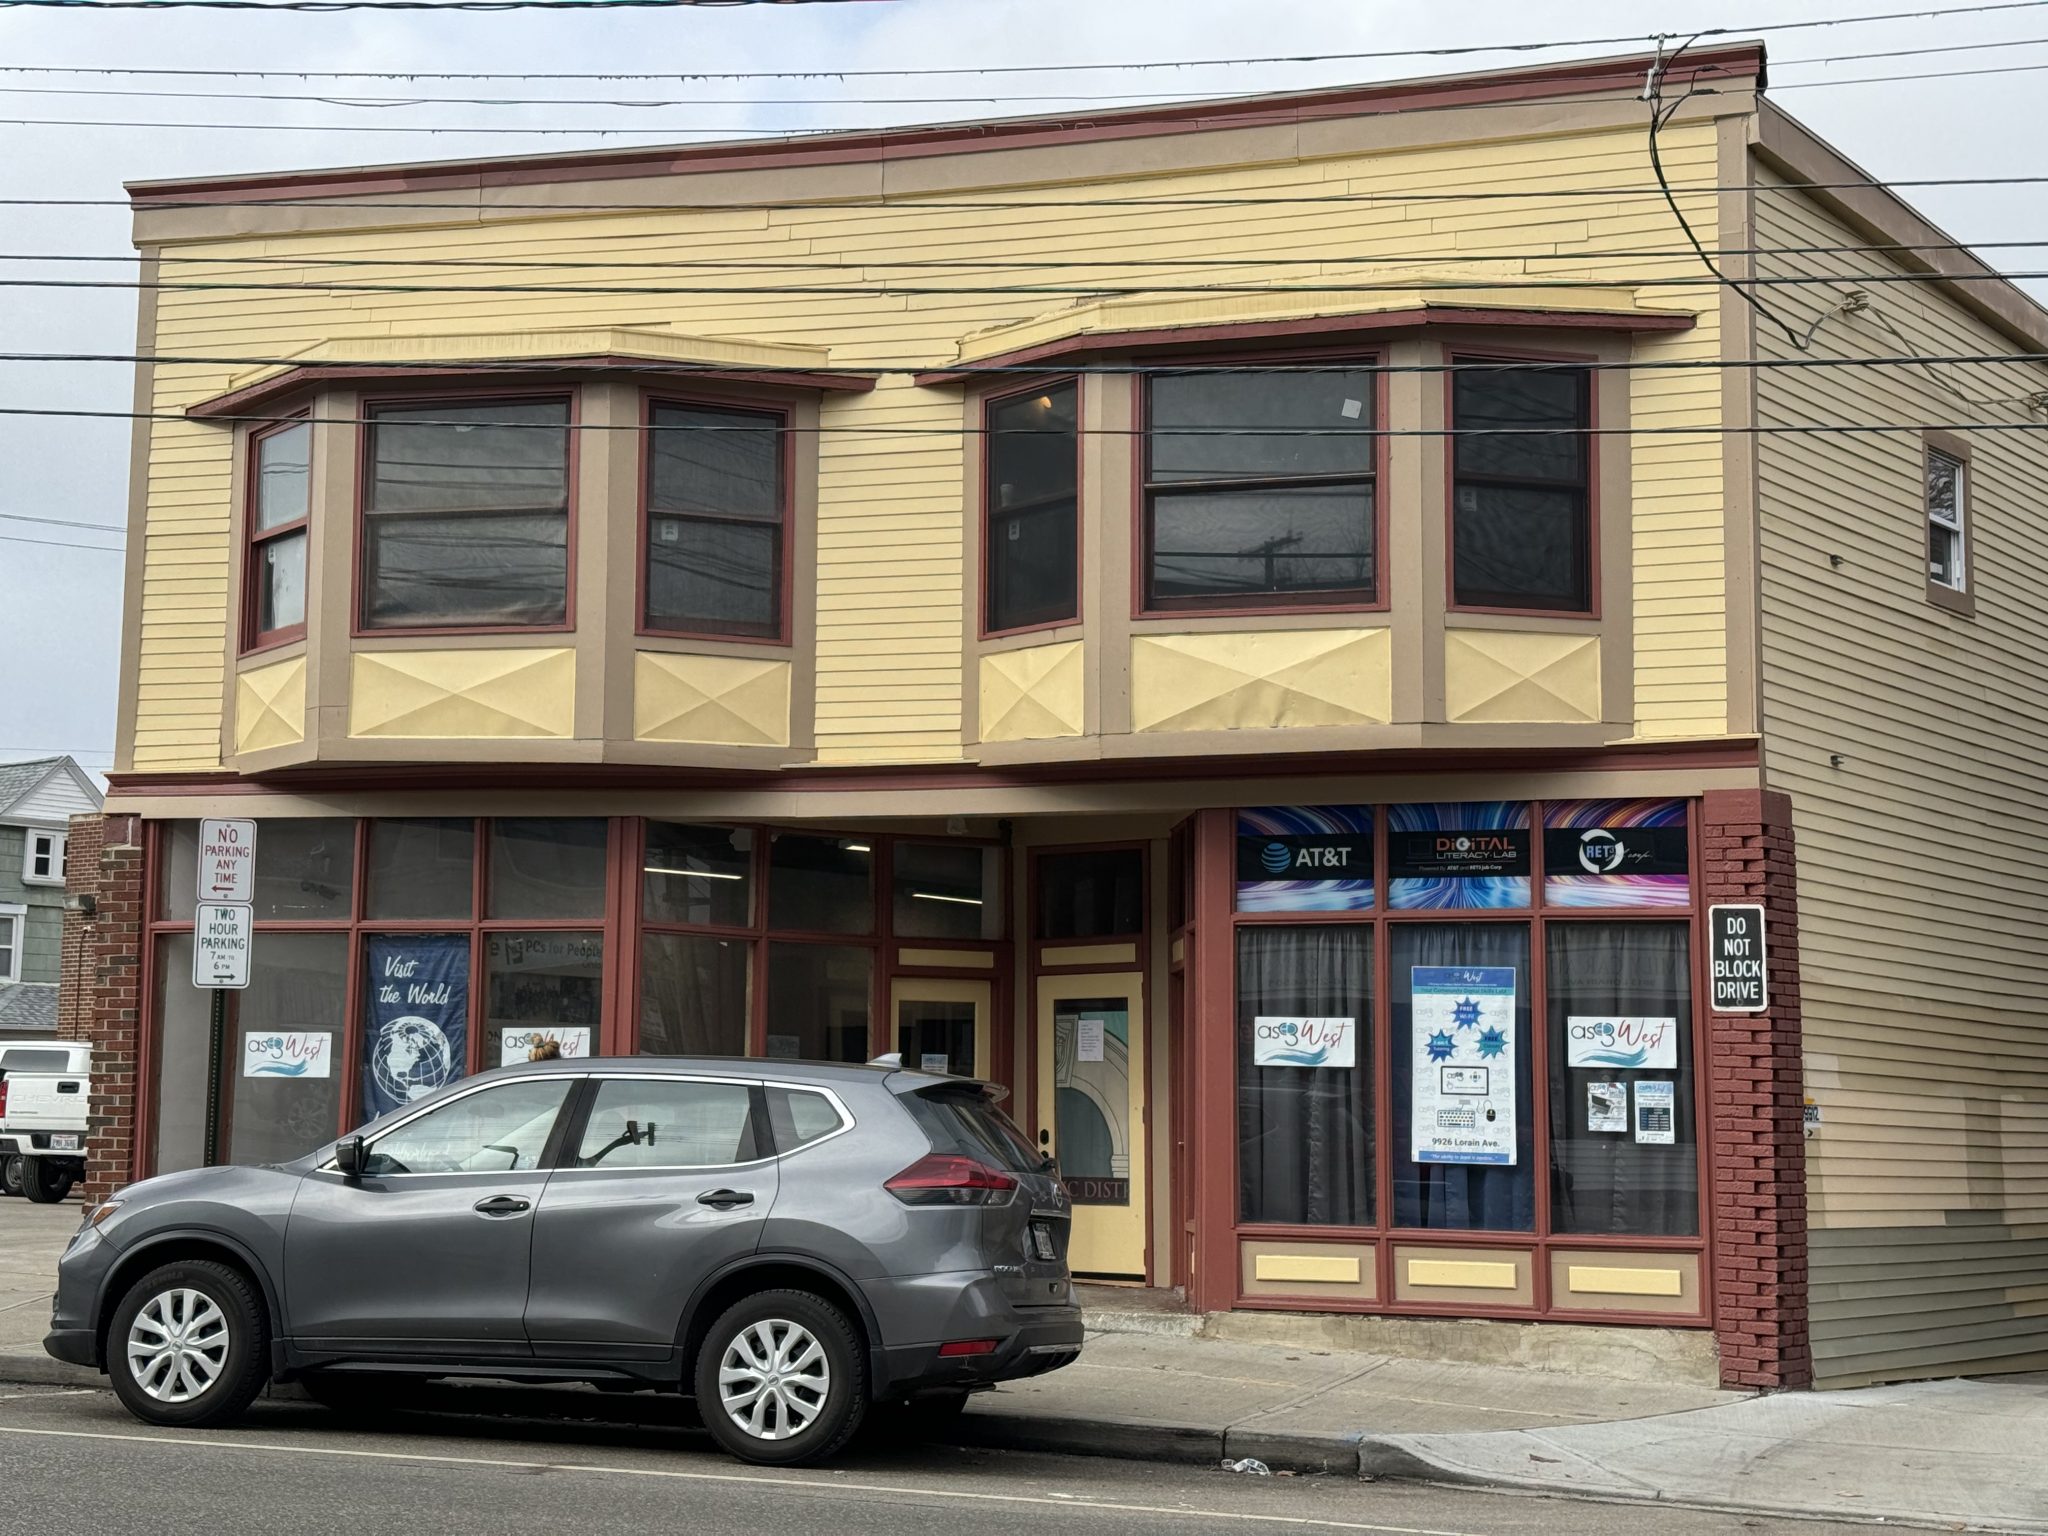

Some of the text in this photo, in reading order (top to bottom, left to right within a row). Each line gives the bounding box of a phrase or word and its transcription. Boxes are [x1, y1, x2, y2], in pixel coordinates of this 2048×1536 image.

[218, 828, 238, 843] NO
[205, 845, 250, 858] PARKING
[1295, 847, 1351, 867] AT&T
[216, 860, 237, 870] ANY
[214, 873, 238, 884] TIME
[214, 908, 235, 921] TWO
[209, 923, 238, 935] HOUR
[1726, 917, 1746, 935] DO
[201, 937, 245, 950] PARKING
[525, 940, 546, 954] PCs
[1724, 938, 1751, 956] NOT
[384, 955, 419, 978] Visit
[1714, 960, 1761, 978] BLOCK
[379, 982, 452, 1005] the World
[1717, 981, 1759, 999] DRIVE
[1301, 1018, 1352, 1048] West
[1618, 1018, 1673, 1049] West
[285, 1033, 328, 1061] West
[1432, 1138, 1452, 1146] 9926
[1454, 1138, 1480, 1147] Lorain
